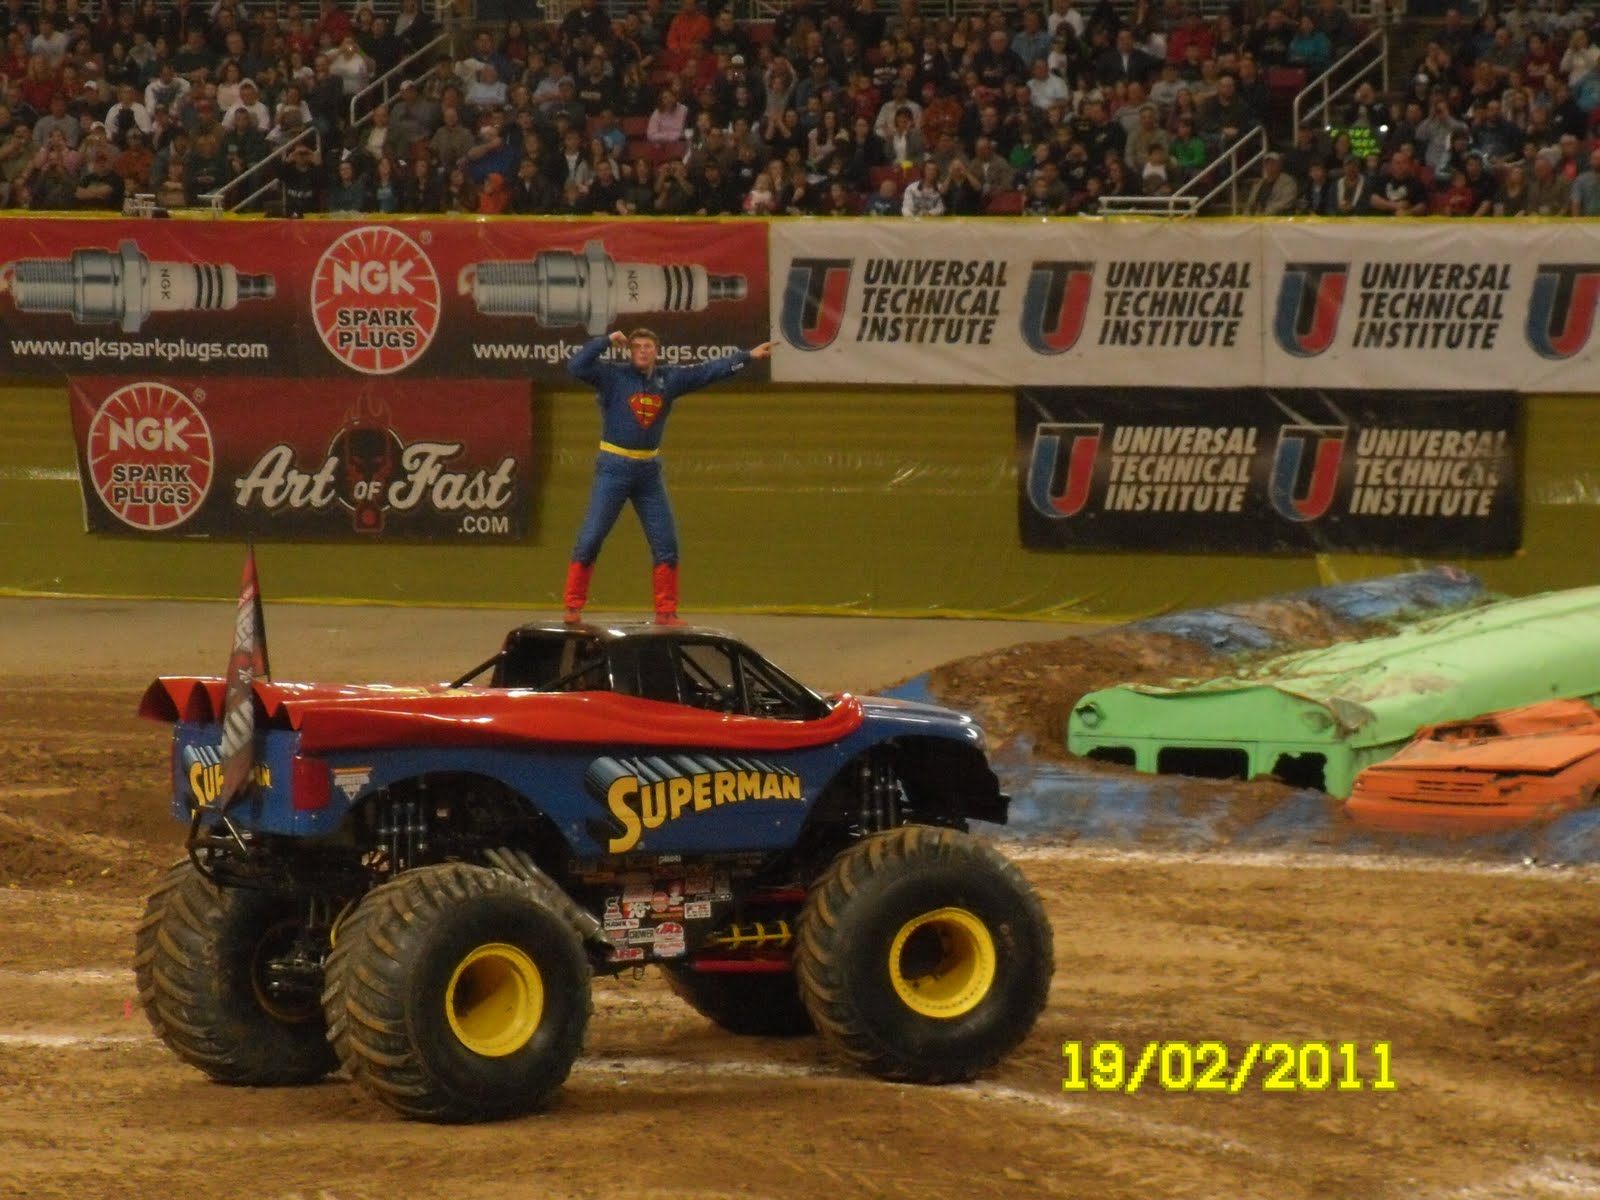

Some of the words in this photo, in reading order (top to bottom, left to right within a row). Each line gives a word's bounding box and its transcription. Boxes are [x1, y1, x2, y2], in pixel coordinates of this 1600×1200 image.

[160, 268, 171, 300] NGK
[333, 260, 418, 295] NGK
[627, 270, 639, 302] NGK
[862, 258, 1007, 288] UNIVERSAL
[1106, 261, 1251, 289] UNIVERSAL
[1360, 262, 1511, 290] UNIVERSAL
[861, 288, 1001, 316] TECHNICAL
[1103, 290, 1244, 319] TECHNICAL
[1358, 292, 1504, 320] TECHNICAL
[337, 309, 415, 327] SPARK
[856, 318, 995, 345] INSTITUTE
[338, 331, 416, 349] PLUGS
[1098, 320, 1239, 347] INSTITUTE
[1352, 322, 1500, 350] INSTITUTE
[11, 337, 269, 361] www.ngksparkplugs.com
[109, 417, 191, 452] NGK
[1111, 426, 1257, 455] UNIVERSAL
[112, 465, 189, 482] SPARK
[235, 444, 339, 508] Art
[354, 481, 380, 500] OF
[388, 443, 515, 510] Fast
[1108, 456, 1251, 484] TECHNICAL
[113, 486, 191, 504] PLUGS
[1104, 485, 1246, 513] INSTITUTE
[1349, 488, 1495, 517] INSTITUTE
[458, 516, 509, 534] .COM
[607, 774, 801, 853] SUPERMAN
